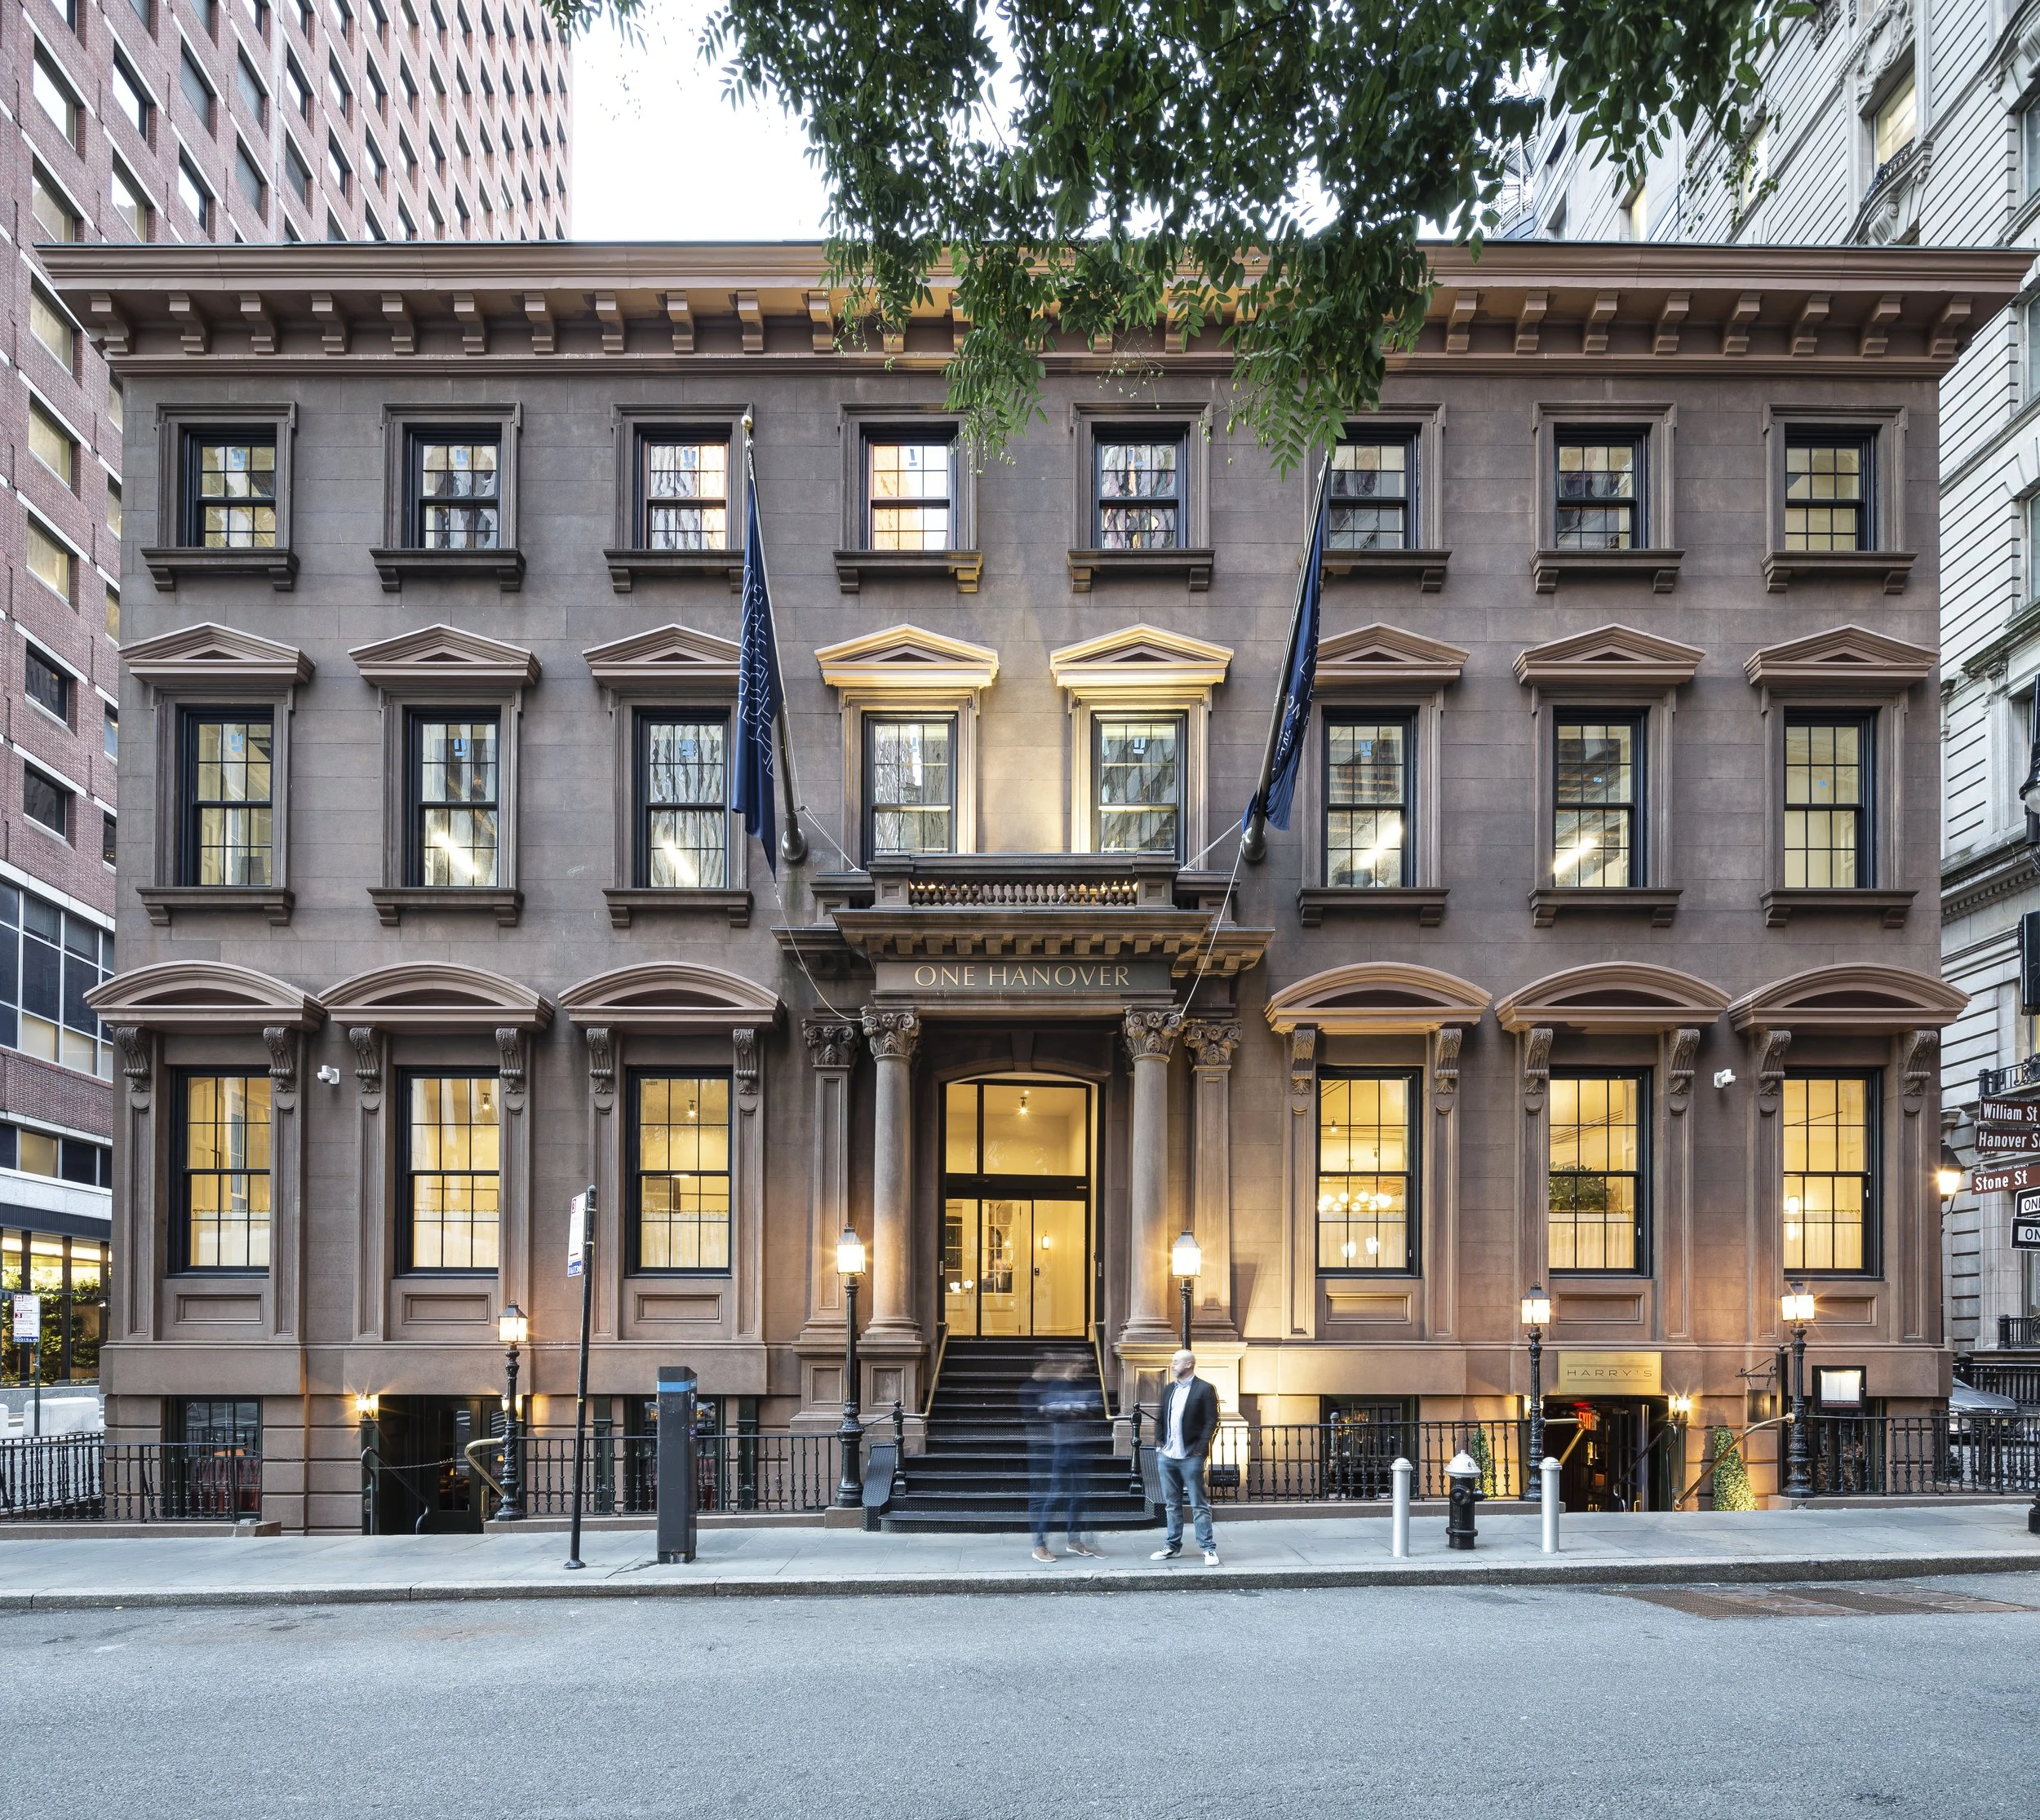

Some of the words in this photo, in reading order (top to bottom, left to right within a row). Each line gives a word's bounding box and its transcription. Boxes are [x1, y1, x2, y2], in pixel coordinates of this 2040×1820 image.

[914, 966, 976, 987] ONE
[989, 966, 1131, 987] HANOVER
[1984, 1103, 2022, 1121] William
[2026, 1105, 2038, 1122] St
[1979, 1131, 2027, 1148] Hanover
[2031, 1133, 2040, 1149] S
[1975, 1176, 2009, 1192] Stone
[2014, 1169, 2028, 1186] St
[1577, 1411, 1592, 1429] EXIT
